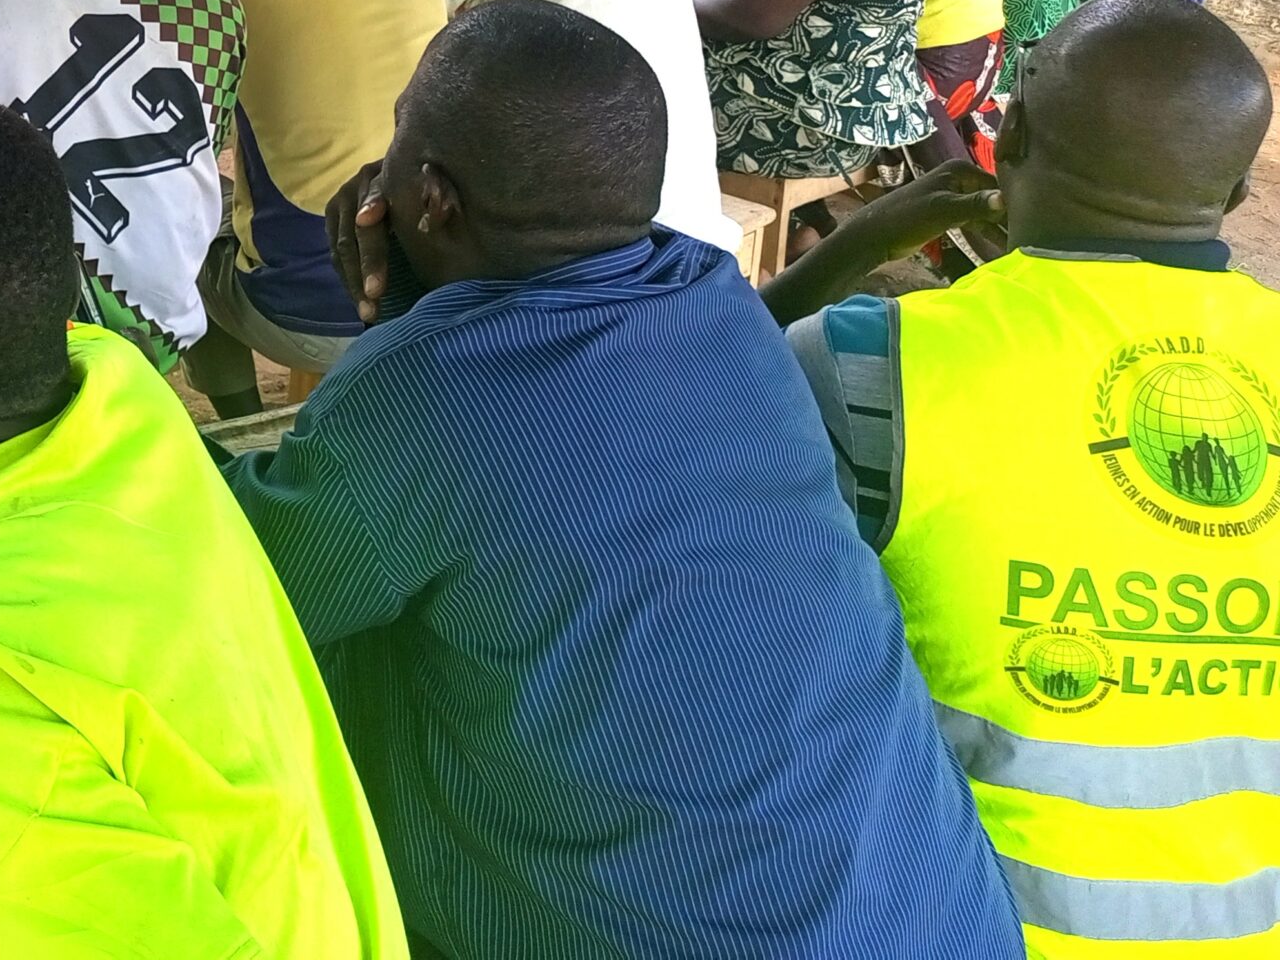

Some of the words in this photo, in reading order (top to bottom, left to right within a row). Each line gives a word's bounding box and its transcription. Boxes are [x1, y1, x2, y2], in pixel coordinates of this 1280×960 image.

[1101, 453, 1130, 487] JEUNES
[1123, 485, 1141, 500] EN
[1135, 496, 1172, 526] ACTION
[1172, 515, 1201, 535] POUR
[1203, 523, 1216, 537] LE
[1007, 559, 1280, 636] PASSO
[1121, 656, 1280, 696] L'ACTI
